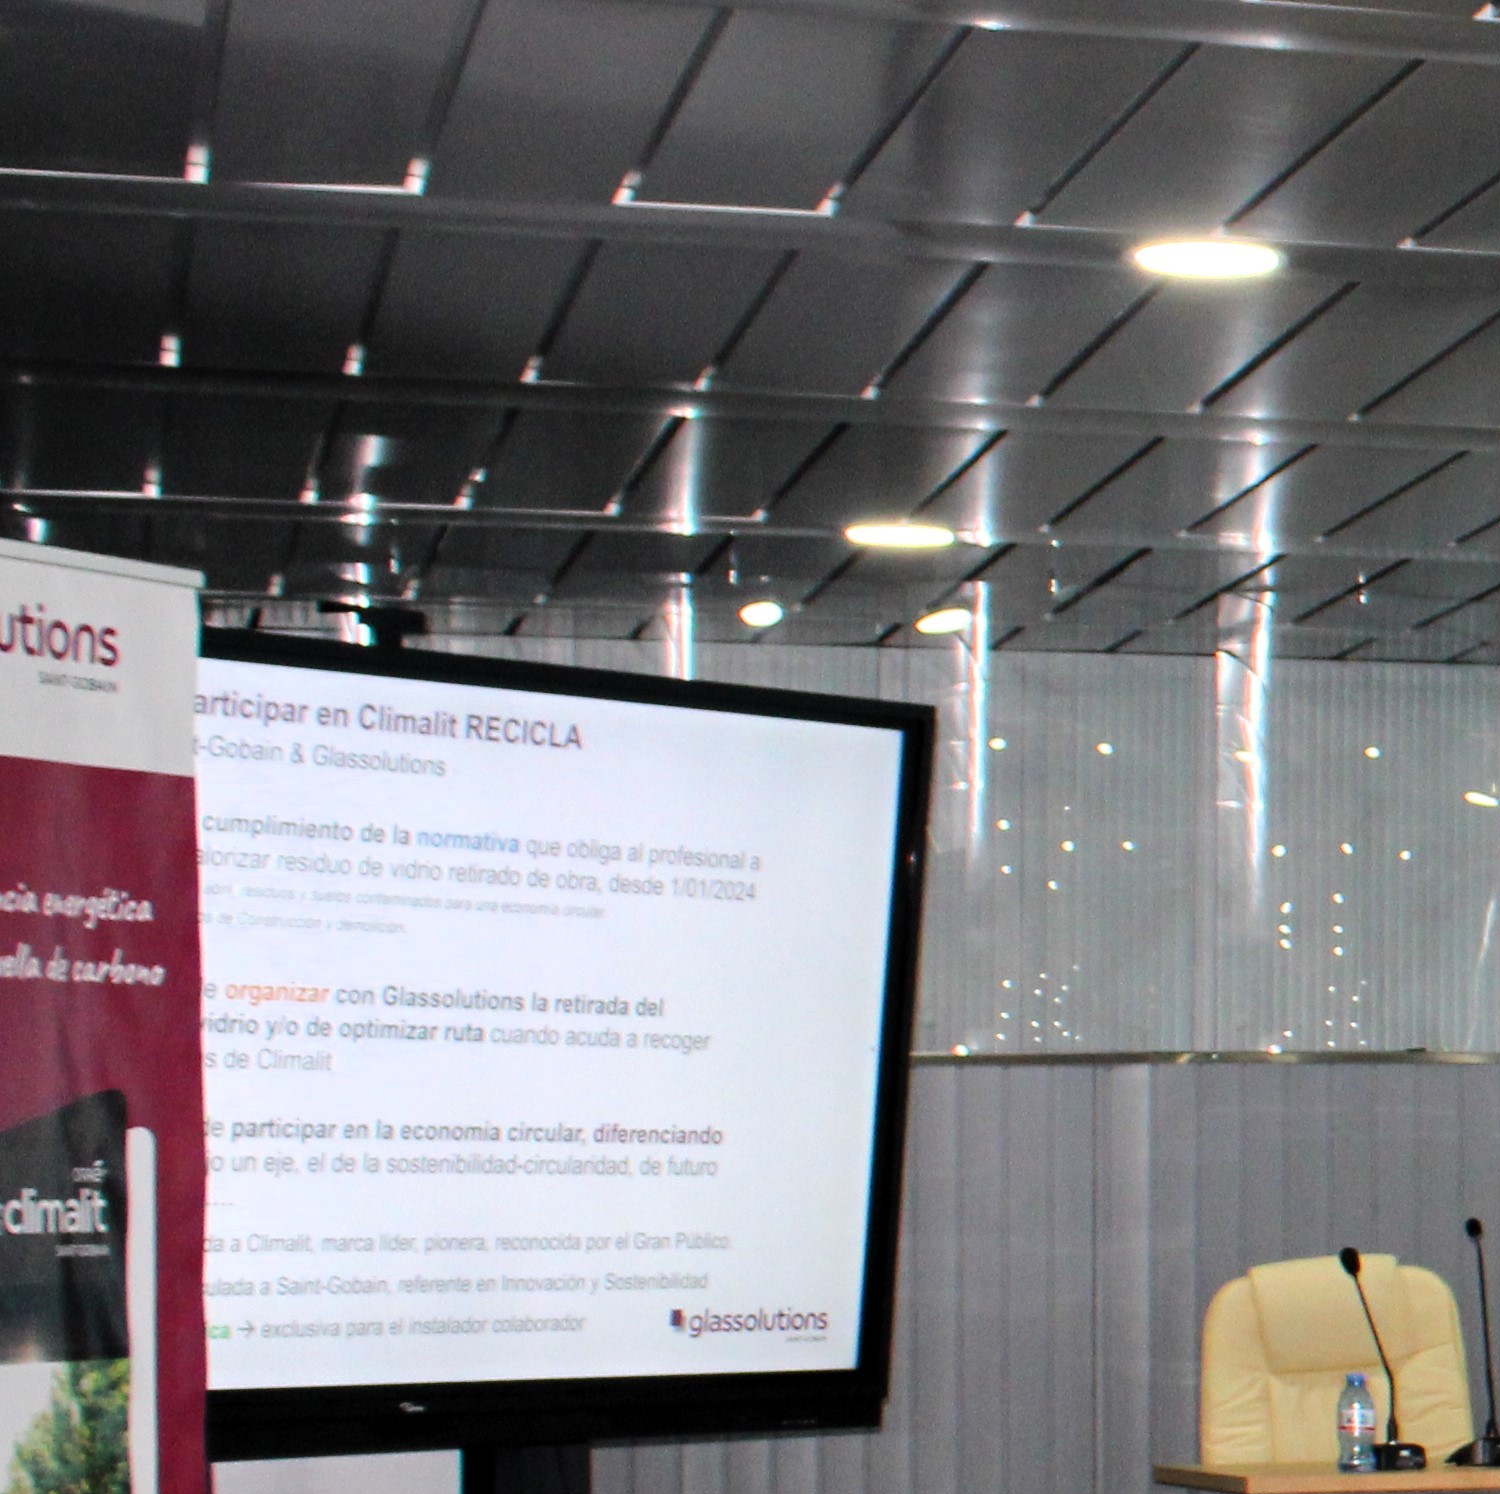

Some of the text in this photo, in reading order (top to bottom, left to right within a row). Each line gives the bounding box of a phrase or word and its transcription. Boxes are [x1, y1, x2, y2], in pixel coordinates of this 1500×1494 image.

[316, 705, 349, 727] en
[359, 703, 458, 737] Climalit
[465, 714, 583, 749] RECICLA
[290, 743, 304, 764] &
[313, 744, 445, 776] Glassolutions
[202, 814, 760, 871] cumplimiento de la normativa que obliga al profesional a
[277, 854, 350, 875] residuo
[358, 856, 383, 877] de
[391, 859, 442, 881] vidrio
[449, 864, 520, 886] retirado
[527, 868, 550, 887] de
[609, 874, 663, 895] desde
[671, 876, 756, 900] 1/01/2024
[43, 887, 155, 928] energética
[46, 945, 70, 982] de
[72, 948, 166, 987] carbono
[225, 982, 329, 1006] organizar
[336, 986, 375, 1004] con
[383, 985, 525, 1011] Glassolutions
[531, 991, 548, 1012] la
[555, 995, 628, 1016] retirada
[635, 997, 665, 1017] del
[266, 1016, 298, 1040] y/o
[307, 1016, 331, 1037] de
[339, 1018, 438, 1042] optimizar
[444, 1022, 484, 1042] ruta
[491, 1023, 559, 1045] cuando
[565, 1027, 620, 1048] acuda
[626, 1031, 638, 1048] a
[643, 1032, 710, 1055] recoger
[224, 1048, 250, 1069] de
[256, 1047, 333, 1071] Climalit
[230, 1117, 336, 1143] participar
[344, 1122, 368, 1140] en
[376, 1118, 393, 1141] la
[593, 1123, 723, 1146] diferenciando
[232, 1155, 256, 1172] un
[308, 1152, 324, 1172] el
[331, 1153, 355, 1173] de
[363, 1152, 380, 1173] la
[640, 1157, 661, 1176] de
[668, 1156, 718, 1177] futuro
[4, 1188, 110, 1235] climalit
[230, 1238, 241, 1253] a
[321, 1237, 373, 1252] marca
[495, 1232, 580, 1252] reconocida
[585, 1236, 611, 1254] por
[615, 1233, 629, 1250] el
[633, 1232, 670, 1250] Gran
[260, 1280, 270, 1296] a
[398, 1273, 470, 1293] referente
[476, 1278, 496, 1293] en
[589, 1276, 599, 1294] y
[604, 1271, 709, 1291] Sostenibilidad
[260, 1319, 340, 1338] exclusiva
[346, 1320, 383, 1340] para
[408, 1316, 488, 1335] instalador
[492, 1314, 586, 1333] colaborador
[689, 1306, 829, 1337] glassolutions
